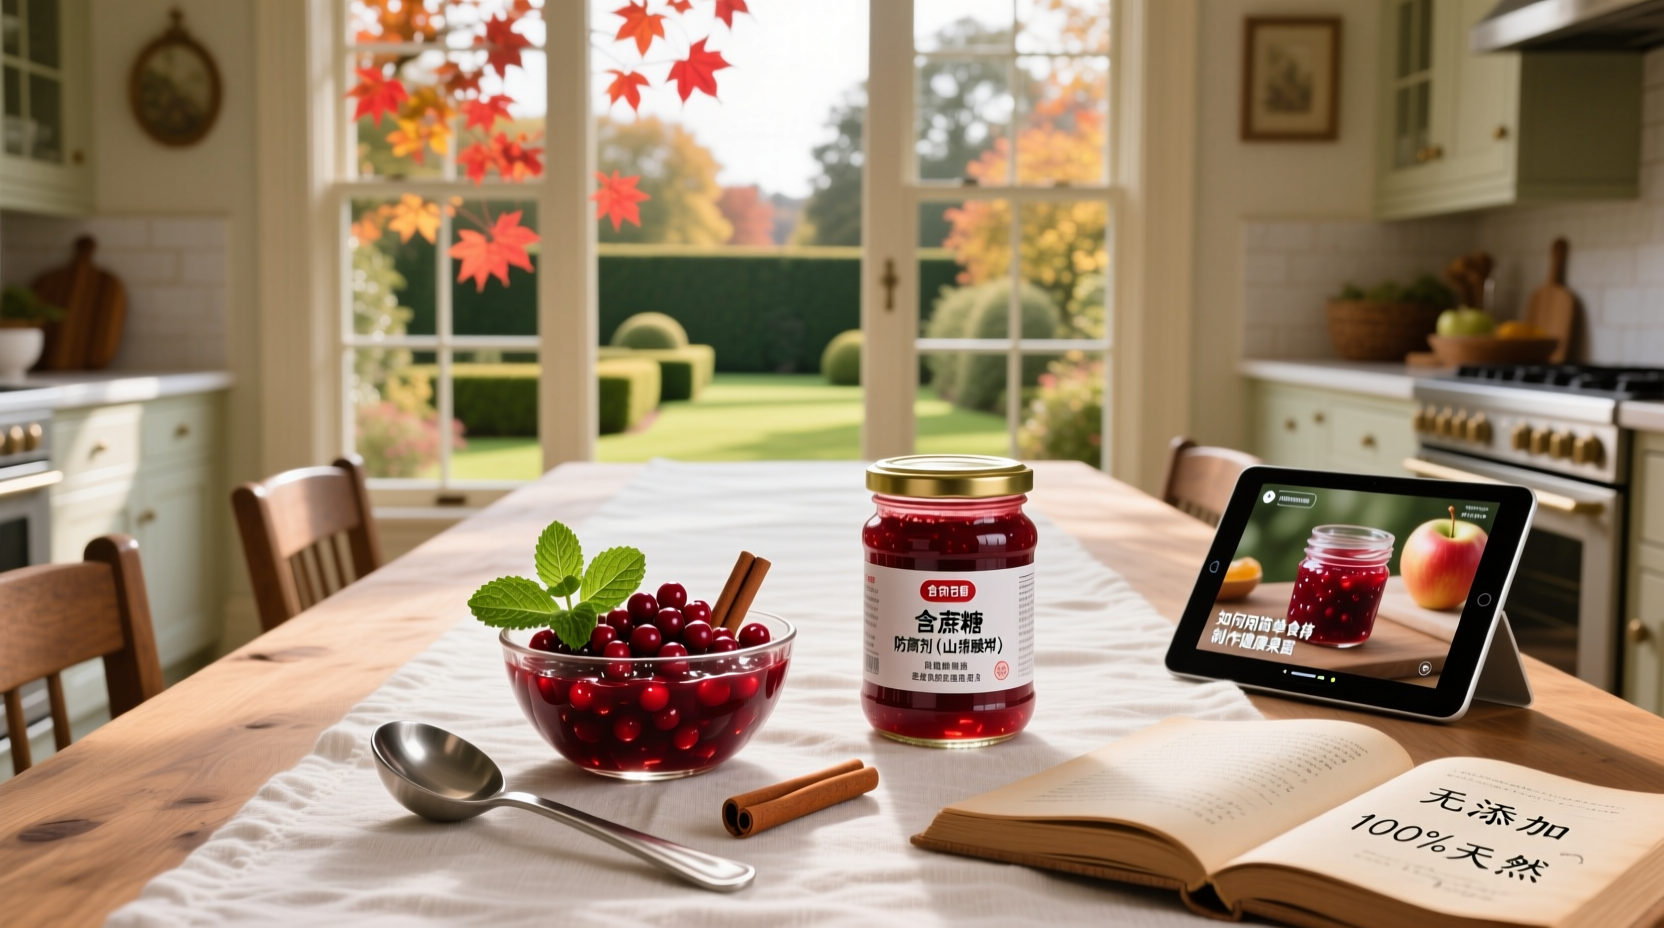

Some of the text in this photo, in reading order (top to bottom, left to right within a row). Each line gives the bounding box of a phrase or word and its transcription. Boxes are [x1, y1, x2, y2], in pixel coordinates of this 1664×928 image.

[915, 609, 983, 634] 含蔗糖
[1419, 787, 1570, 840] 无添加
[1351, 813, 1549, 883] 100%天然
